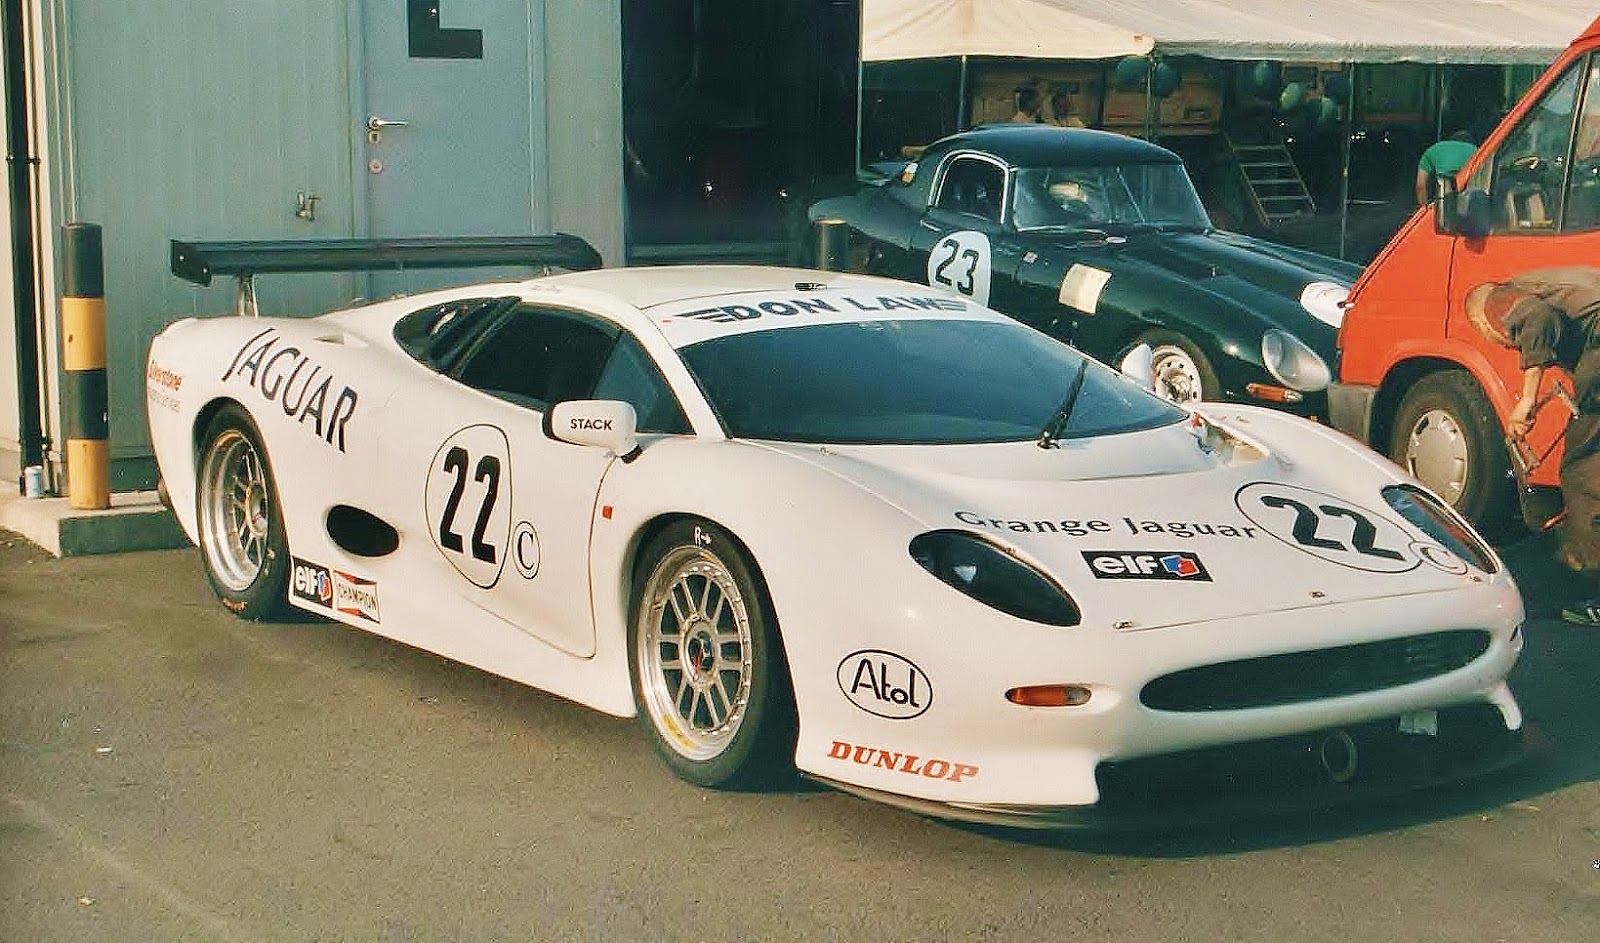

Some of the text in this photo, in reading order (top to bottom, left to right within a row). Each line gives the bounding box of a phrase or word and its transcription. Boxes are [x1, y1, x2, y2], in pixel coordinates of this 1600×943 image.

[935, 238, 979, 296] 23
[715, 298, 841, 323] DON
[221, 328, 358, 454] JAGUAR
[569, 418, 613, 431] STACK
[439, 446, 501, 564] 22
[954, 511, 1257, 539] Grange Jaguar
[1260, 495, 1407, 562] 22
[517, 531, 534, 571] C
[1092, 554, 1158, 575] elf
[295, 566, 319, 596] elf
[851, 658, 920, 708] Atol
[827, 740, 980, 783] DUNLOP
